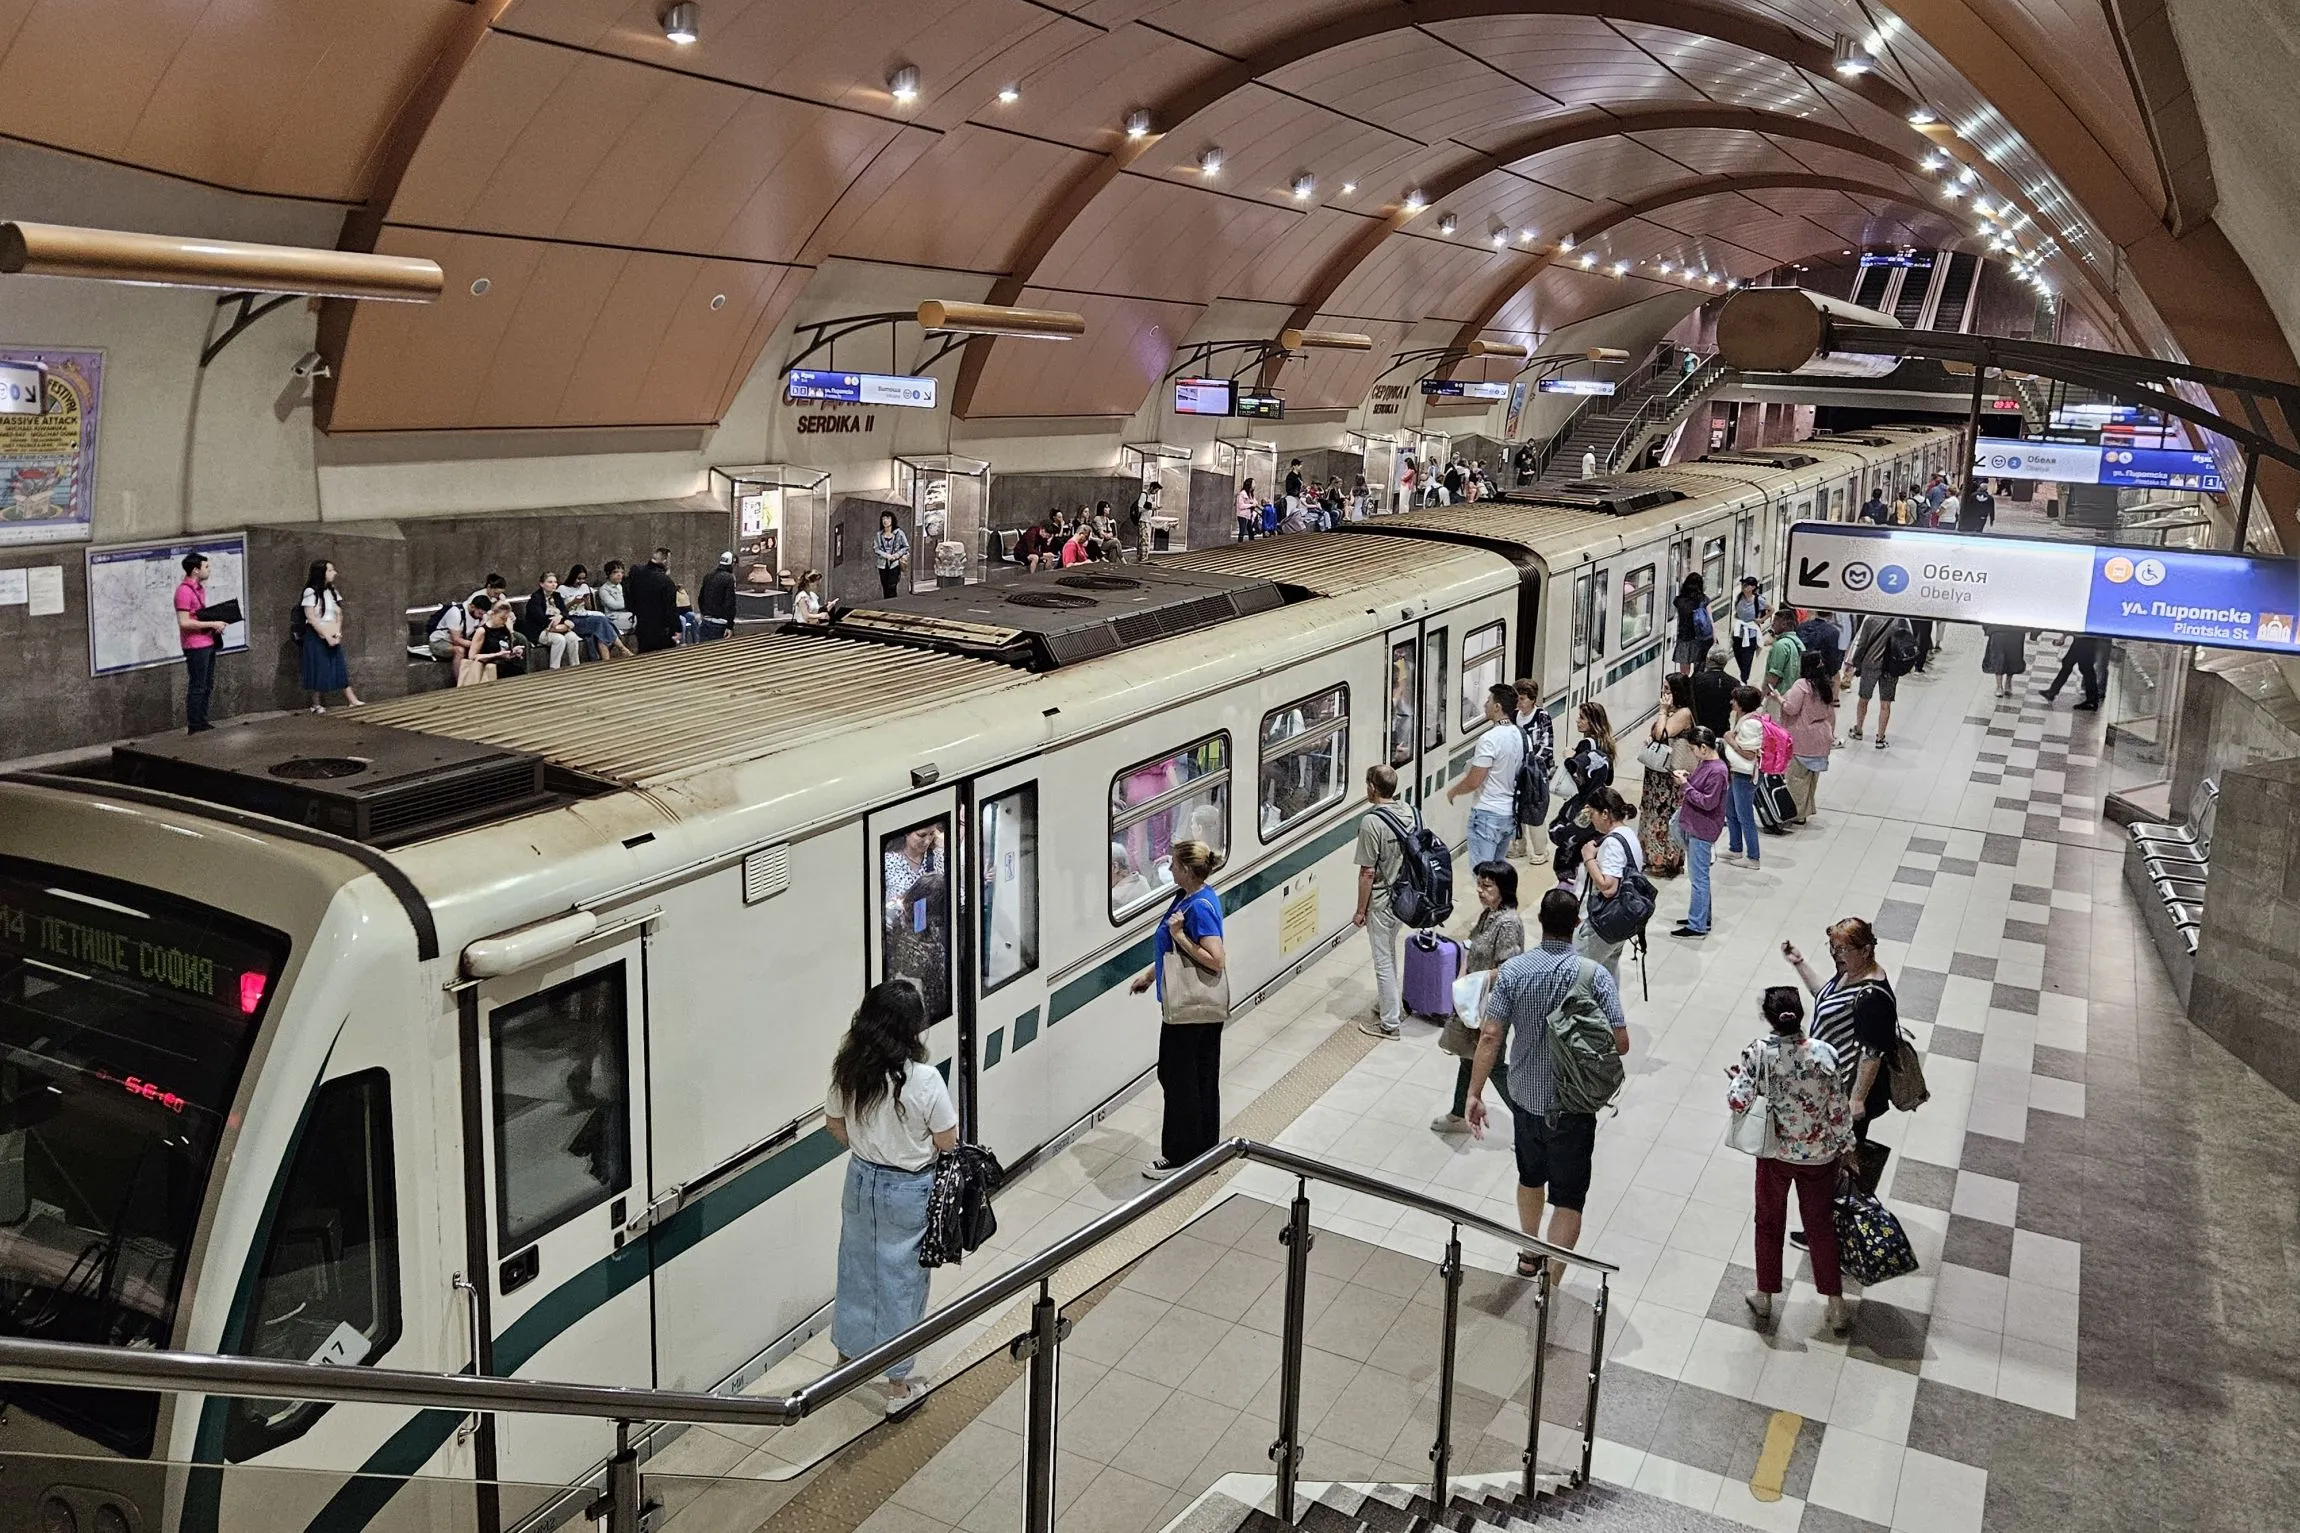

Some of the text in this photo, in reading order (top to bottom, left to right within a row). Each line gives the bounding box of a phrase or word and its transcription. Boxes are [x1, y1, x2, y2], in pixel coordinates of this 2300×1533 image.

[1372, 385, 1404, 401] СЕРДИКА
[1373, 404, 1394, 414] SERDIKA
[42, 416, 77, 425] ATTACK
[797, 415, 875, 433] SERDIKA II
[2028, 456, 2056, 464] Обеля
[2126, 470, 2167, 479] Пиротска
[1888, 574, 1897, 585] 2
[1923, 564, 1987, 584] Обеля
[1920, 586, 1972, 603] Obelya
[2121, 601, 2251, 624] ул. Пиротска
[2173, 623, 2249, 640] Pirotska St
